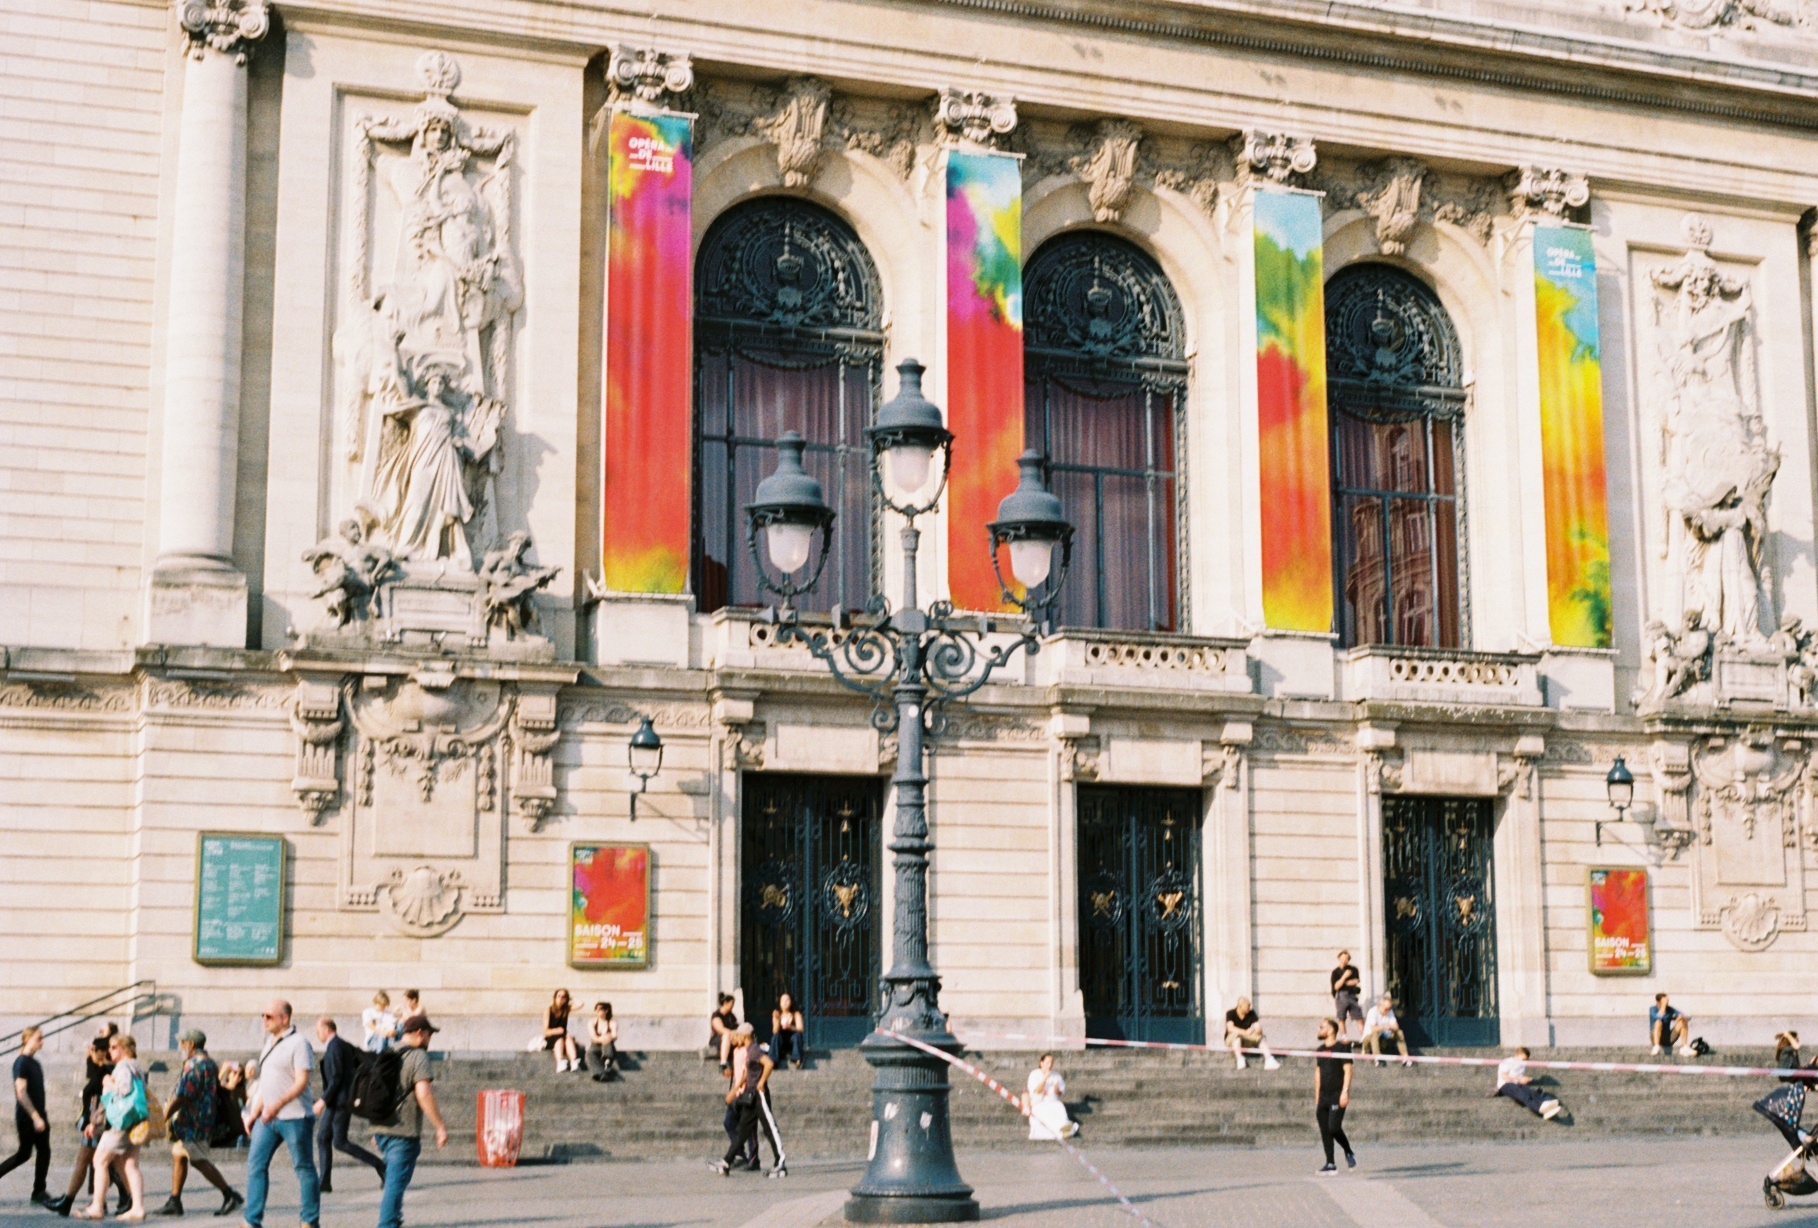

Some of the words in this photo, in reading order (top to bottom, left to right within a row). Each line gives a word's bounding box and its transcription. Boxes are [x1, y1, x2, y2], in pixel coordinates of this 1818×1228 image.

[638, 149, 653, 160] DE
[646, 160, 673, 173] LILLE
[575, 924, 621, 938] SAISON
[1595, 937, 1629, 948] SAISON
